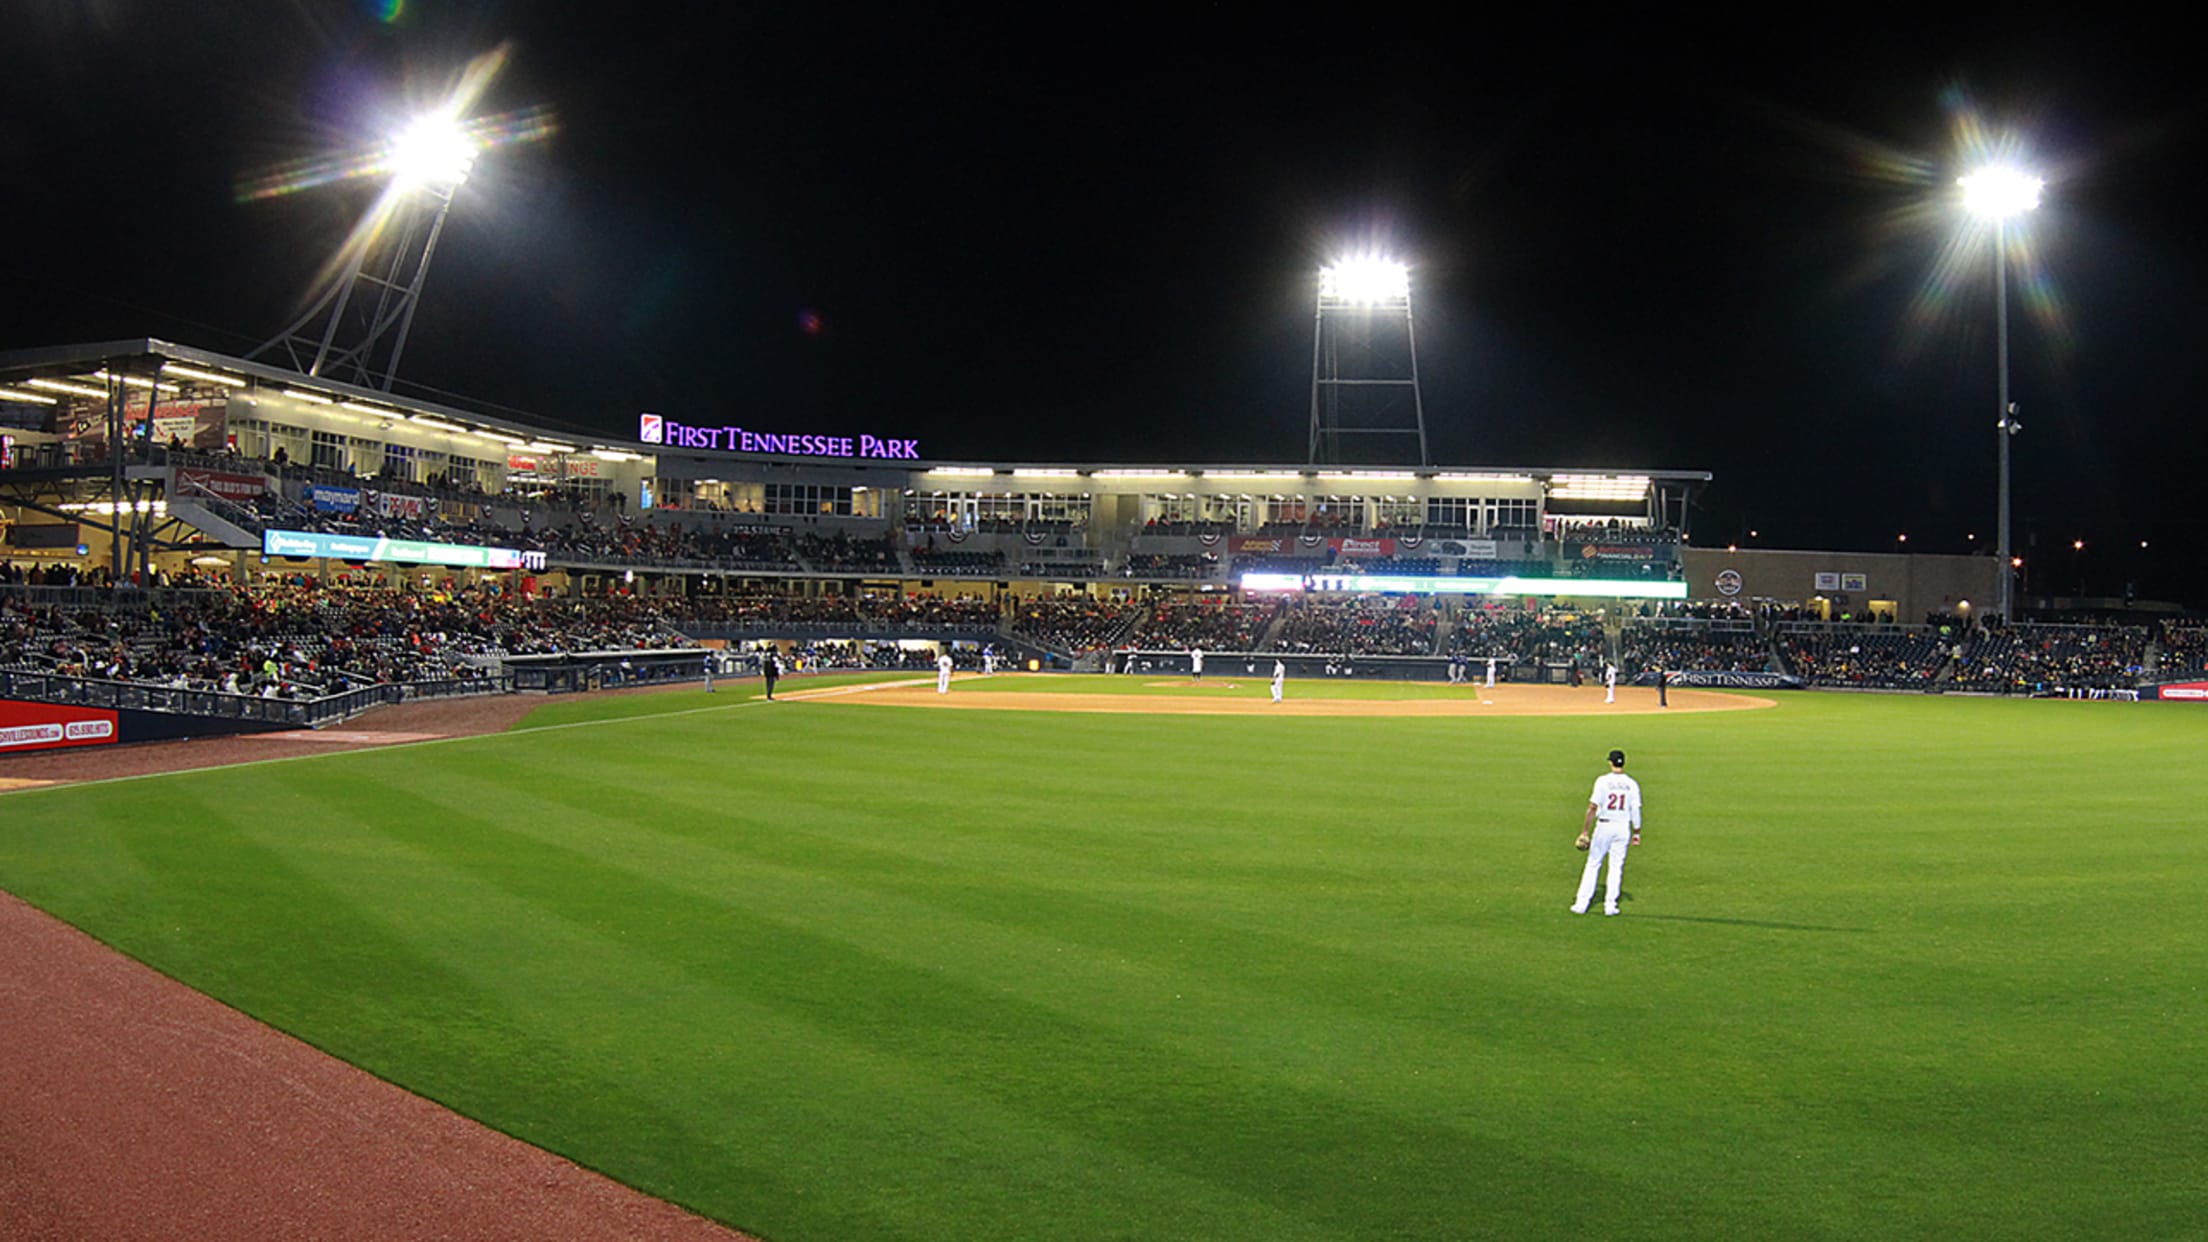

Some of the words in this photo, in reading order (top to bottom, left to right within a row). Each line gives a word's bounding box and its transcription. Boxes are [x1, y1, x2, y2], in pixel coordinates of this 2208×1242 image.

[665, 421, 722, 448] FIRST
[723, 426, 854, 457] TENNESSEE
[860, 434, 920, 459] PARK
[1682, 672, 1712, 686] FIRST
[1607, 793, 1625, 811] 21
